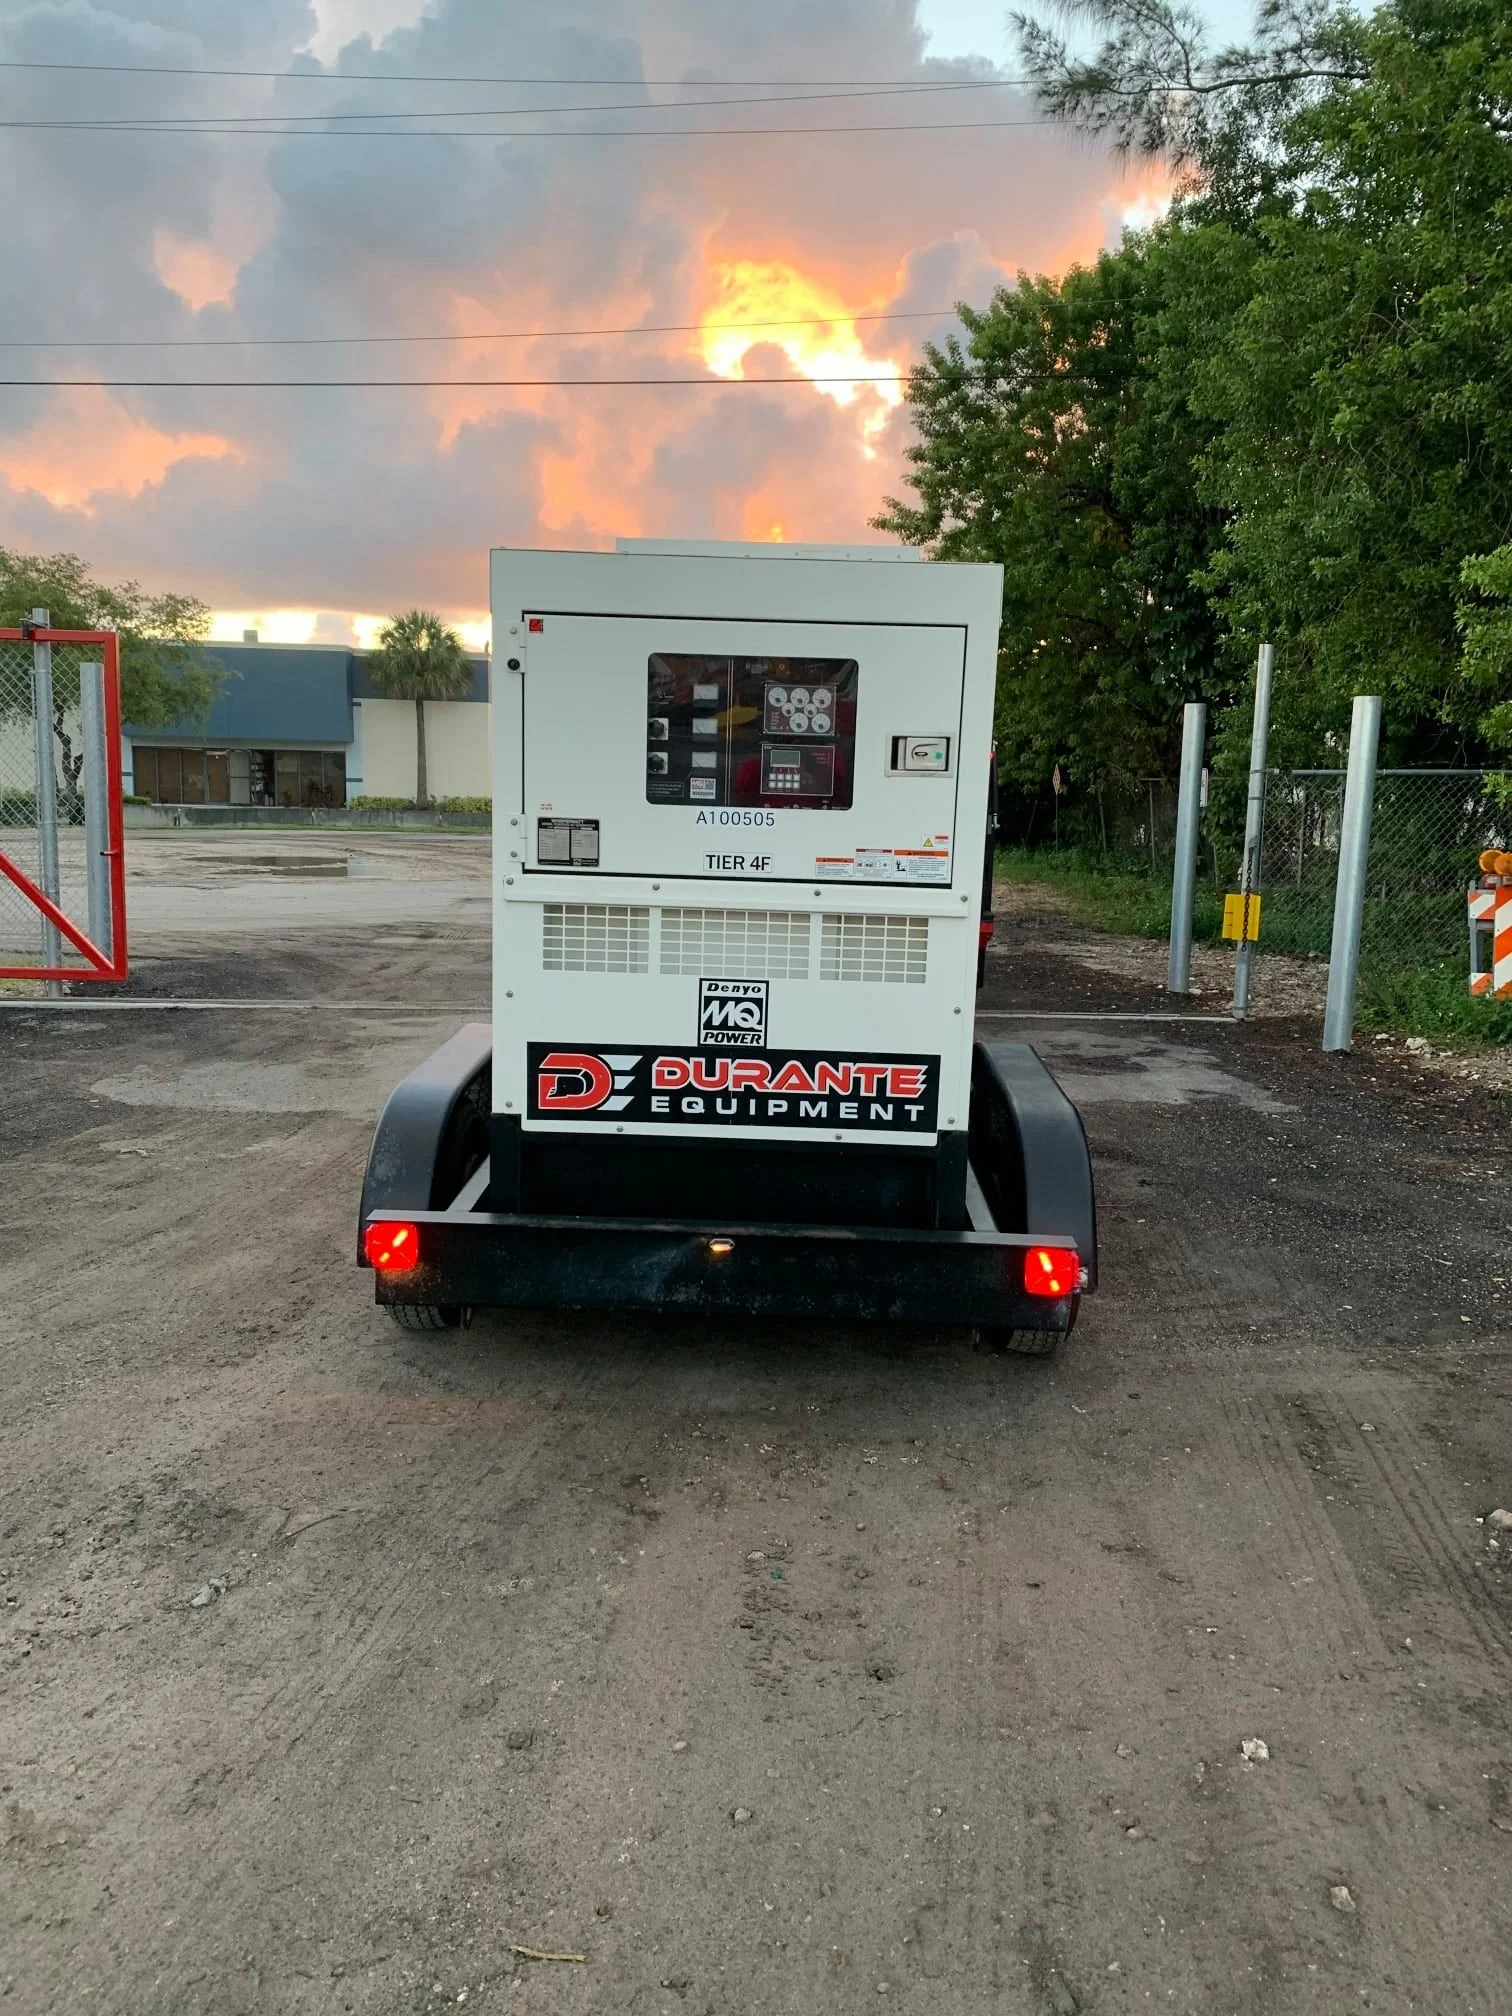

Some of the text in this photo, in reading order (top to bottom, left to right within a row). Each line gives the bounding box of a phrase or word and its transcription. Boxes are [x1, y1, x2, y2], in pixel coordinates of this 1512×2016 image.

[696, 810, 775, 827] A100505
[705, 854, 771, 871] TIER 4F
[706, 982, 762, 996] Denyo
[701, 1000, 763, 1031] MQ
[702, 1031, 762, 1045] POWER
[653, 1056, 928, 1097] DURANTE
[651, 1095, 924, 1122] EQUIPMENT
